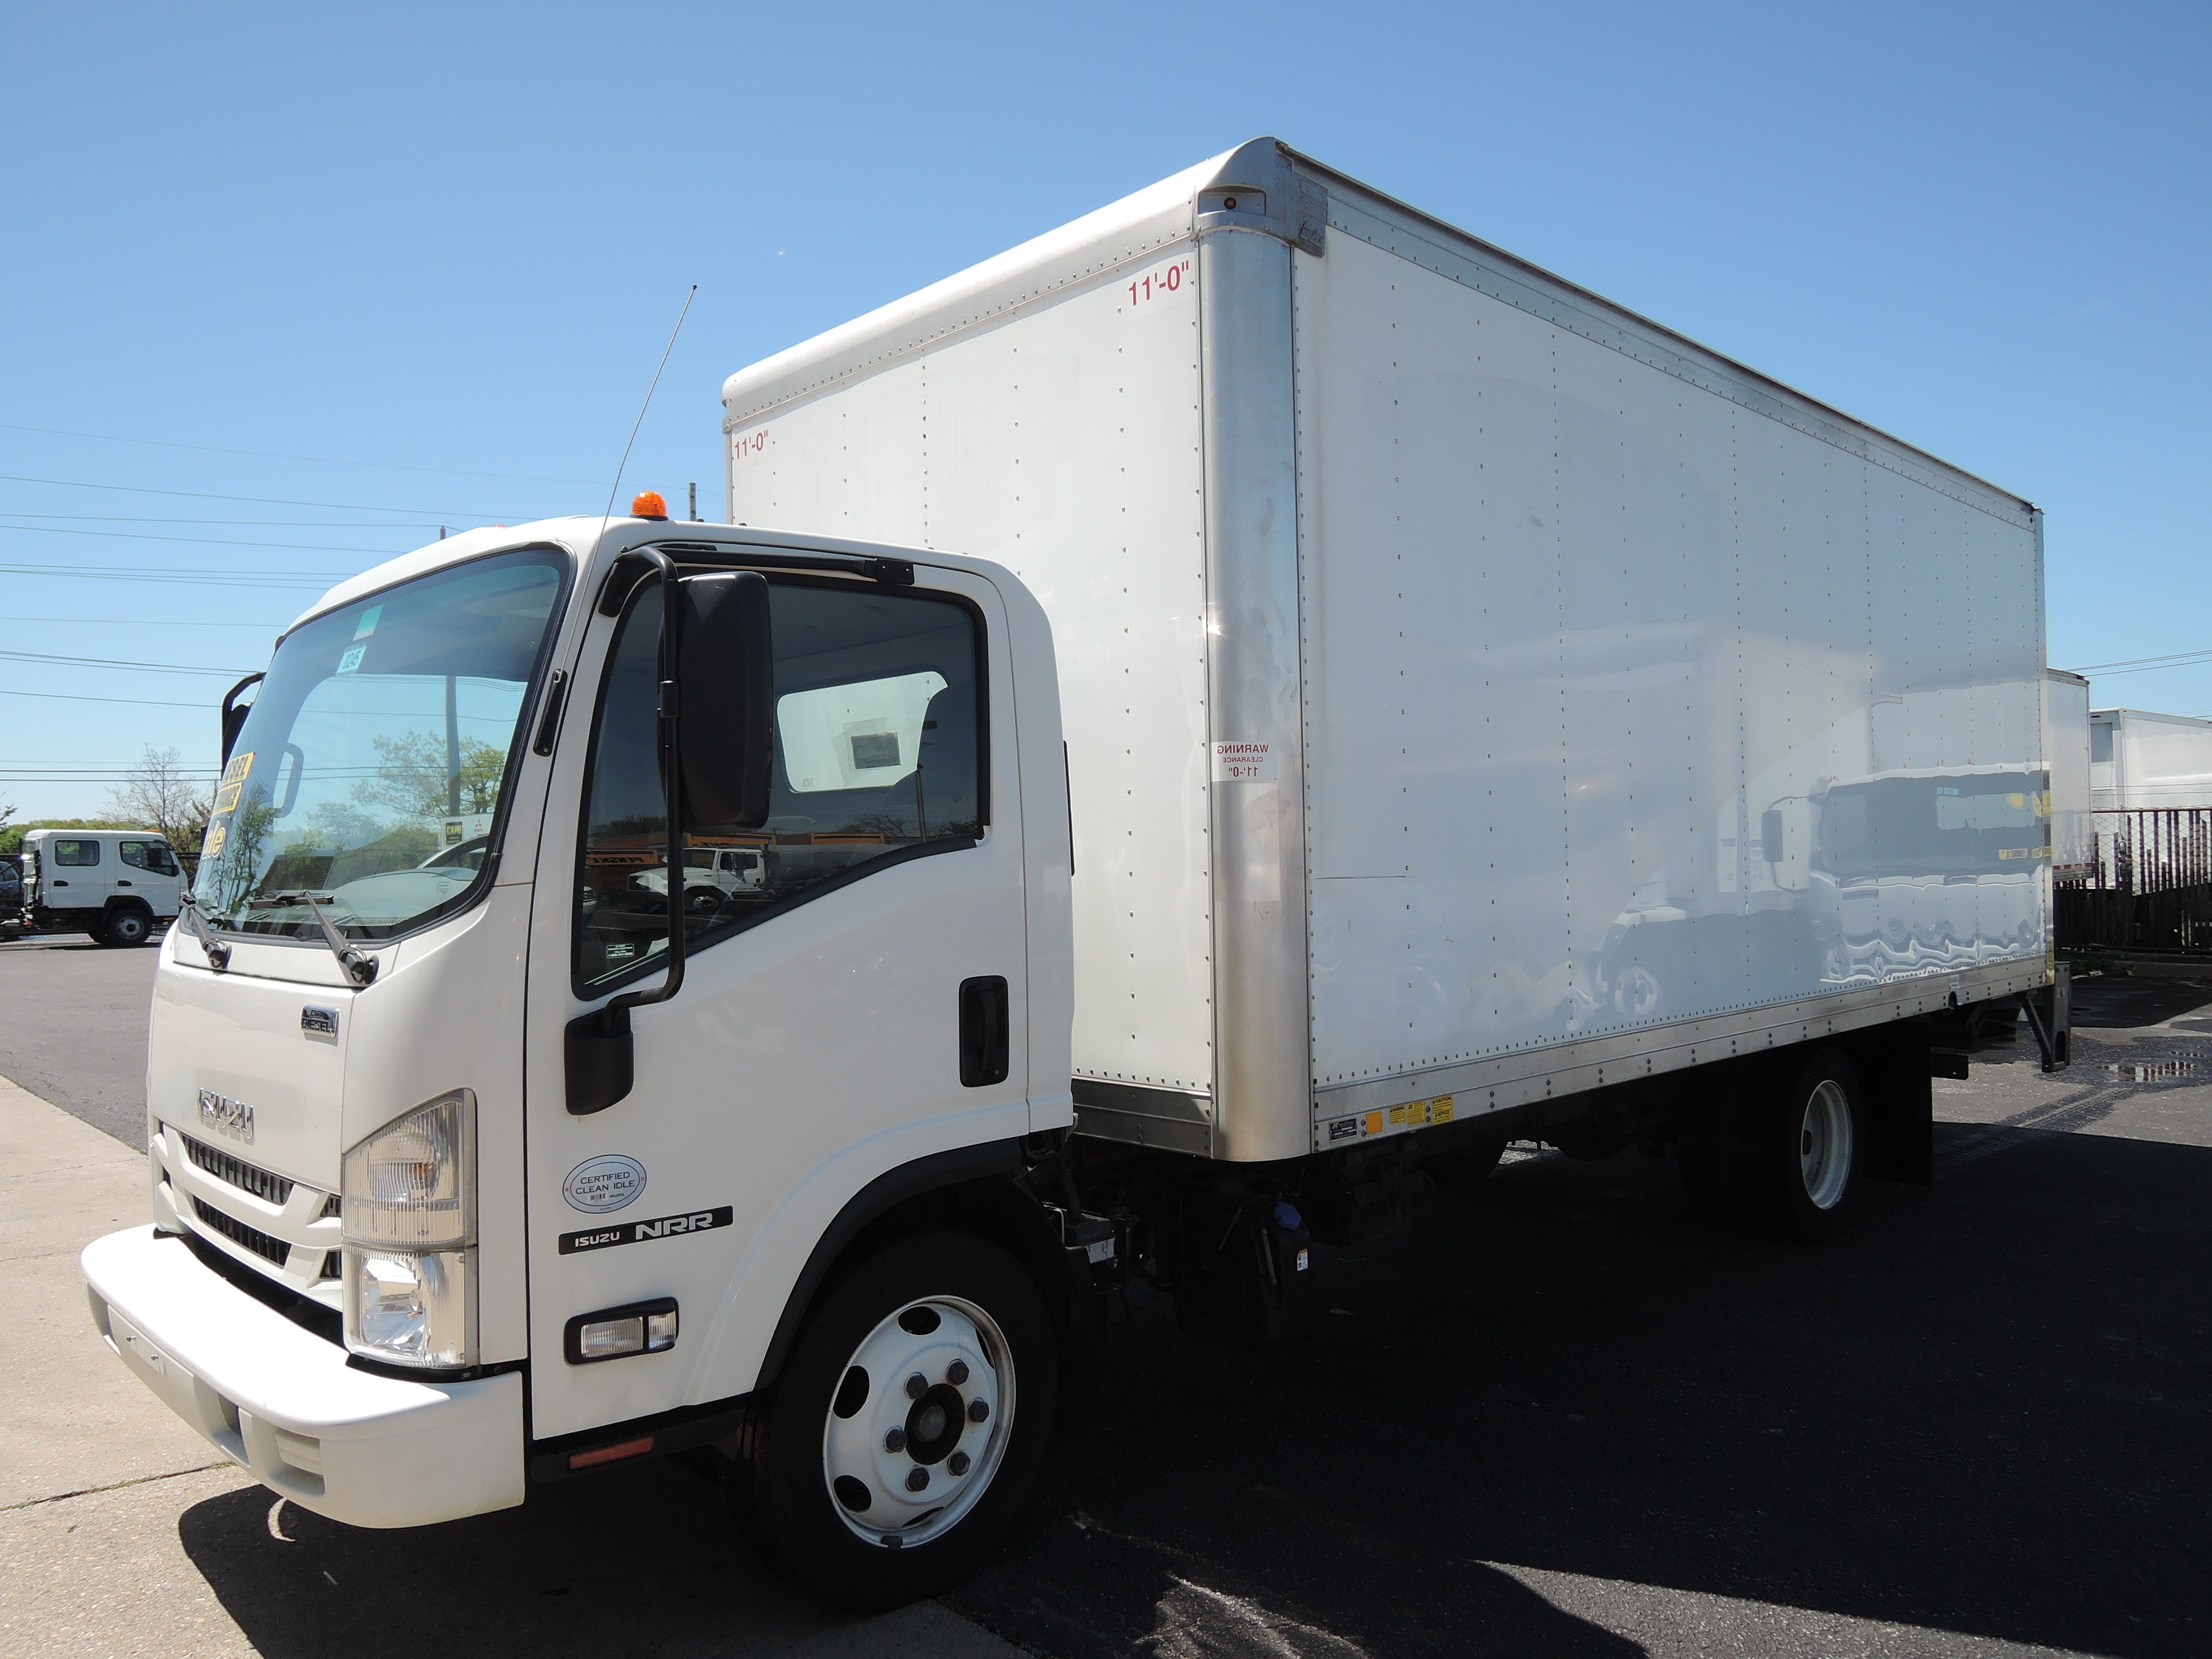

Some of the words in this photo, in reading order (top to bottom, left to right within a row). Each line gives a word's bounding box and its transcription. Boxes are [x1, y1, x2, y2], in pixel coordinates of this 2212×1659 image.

[1128, 260, 1189, 306] 11'-0"
[734, 429, 768, 460] 11'-0"
[198, 1087, 254, 1140] ISUZU
[575, 1183, 609, 1195] CLEAN
[613, 1180, 635, 1190] IDLE
[580, 1171, 630, 1185] CERTIFIED
[575, 1231, 620, 1248] ISUZU
[635, 1213, 713, 1240] NRR
